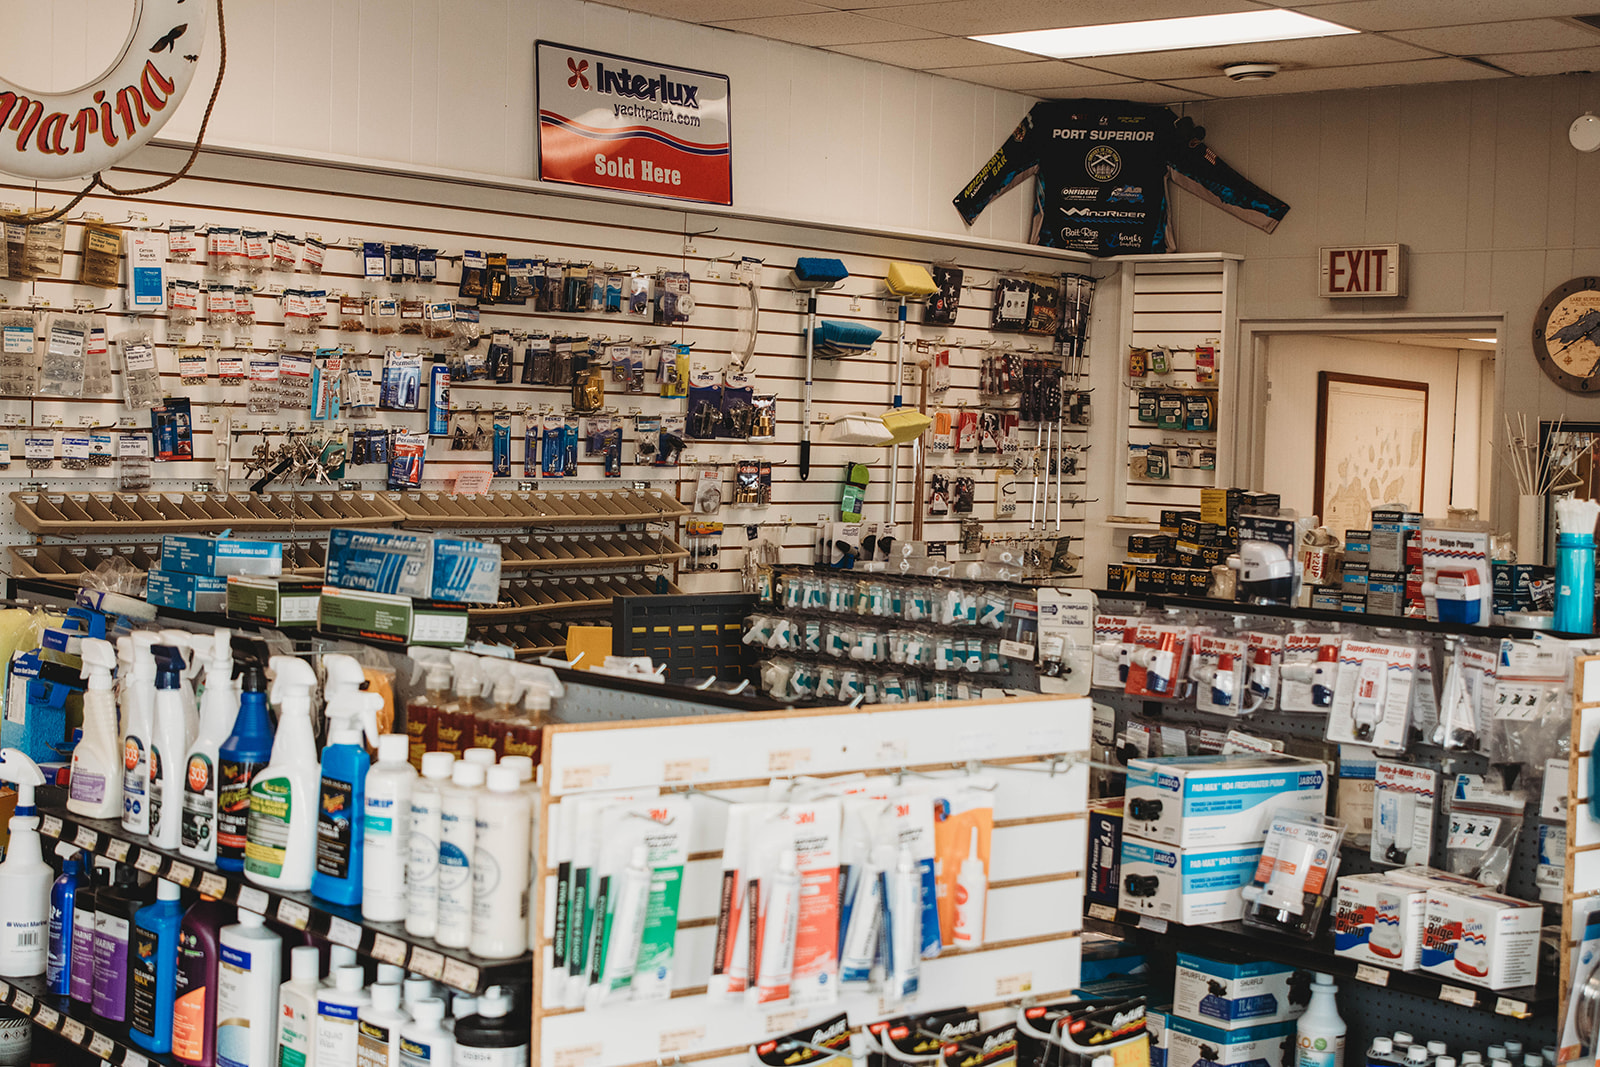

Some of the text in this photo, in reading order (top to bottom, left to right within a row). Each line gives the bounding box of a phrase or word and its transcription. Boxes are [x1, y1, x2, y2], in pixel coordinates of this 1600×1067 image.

[596, 62, 699, 109] Interlux
[614, 103, 700, 127] yachtpaint.com
[1052, 129, 1155, 142] PORT SUPERIOR
[594, 153, 681, 186] Sold Here
[1329, 249, 1388, 292] EXIT
[1583, 278, 1597, 290] 12
[1535, 328, 1543, 340] 9
[391, 359, 420, 367] Permatex
[732, 374, 748, 382] PERKO
[1581, 378, 1589, 391] 6
[396, 437, 425, 445] Permatex
[1180, 523, 1196, 534] Gold
[350, 534, 427, 551] CHALLENGER
[1439, 538, 1455, 548] Bilge
[1456, 540, 1474, 549] Pump
[1180, 554, 1193, 563] Gold
[1203, 550, 1219, 560] Gold
[1108, 567, 1121, 576] Gold
[1136, 569, 1150, 579] Gold
[1151, 570, 1165, 579] Gold
[1170, 572, 1186, 581] Gold
[1190, 574, 1206, 584] Gold
[1097, 616, 1127, 626] Bilge Pump
[1202, 638, 1214, 648] Bilge
[1214, 640, 1226, 650] Pump
[1251, 635, 1263, 644] Pump
[1288, 635, 1321, 644] Bilge Pump
[1345, 643, 1412, 660] SuperSwitch rule
[126, 747, 138, 761] 303
[190, 765, 207, 781] 303
[1378, 764, 1432, 781] Rule-A-Matic rule
[1158, 777, 1178, 789] JABSCO
[1221, 779, 1286, 790] HD4 FRESHWATER PUMP
[1298, 775, 1321, 785] JABSCO
[649, 809, 667, 819] 3M
[896, 804, 909, 817] 3M
[794, 811, 815, 825] 3M
[1101, 820, 1112, 846] 4.0
[1273, 824, 1299, 834] SEAFLO
[1304, 829, 1334, 840] 2000 GPH
[1155, 851, 1174, 862] JABSCO
[1090, 838, 1100, 892] Water Pressure
[1338, 899, 1367, 911] 2000 GPH
[1337, 907, 1364, 924] Bilge
[1427, 914, 1441, 923] 1500
[29, 920, 48, 928] Marine
[1337, 920, 1365, 939] Pump
[1426, 922, 1454, 939] Bilge
[95, 938, 116, 952] MARINE
[1426, 936, 1455, 955] Pump
[134, 968, 155, 982] CLEANER
[134, 975, 149, 987] WAX
[1180, 968, 1207, 982] SHURFLO
[1239, 977, 1264, 987] SHURFLO
[283, 1003, 294, 1019] 3M
[319, 1028, 344, 1040] Liquid
[1172, 1033, 1199, 1047] SHURFLO
[358, 1045, 388, 1064] MARINE
